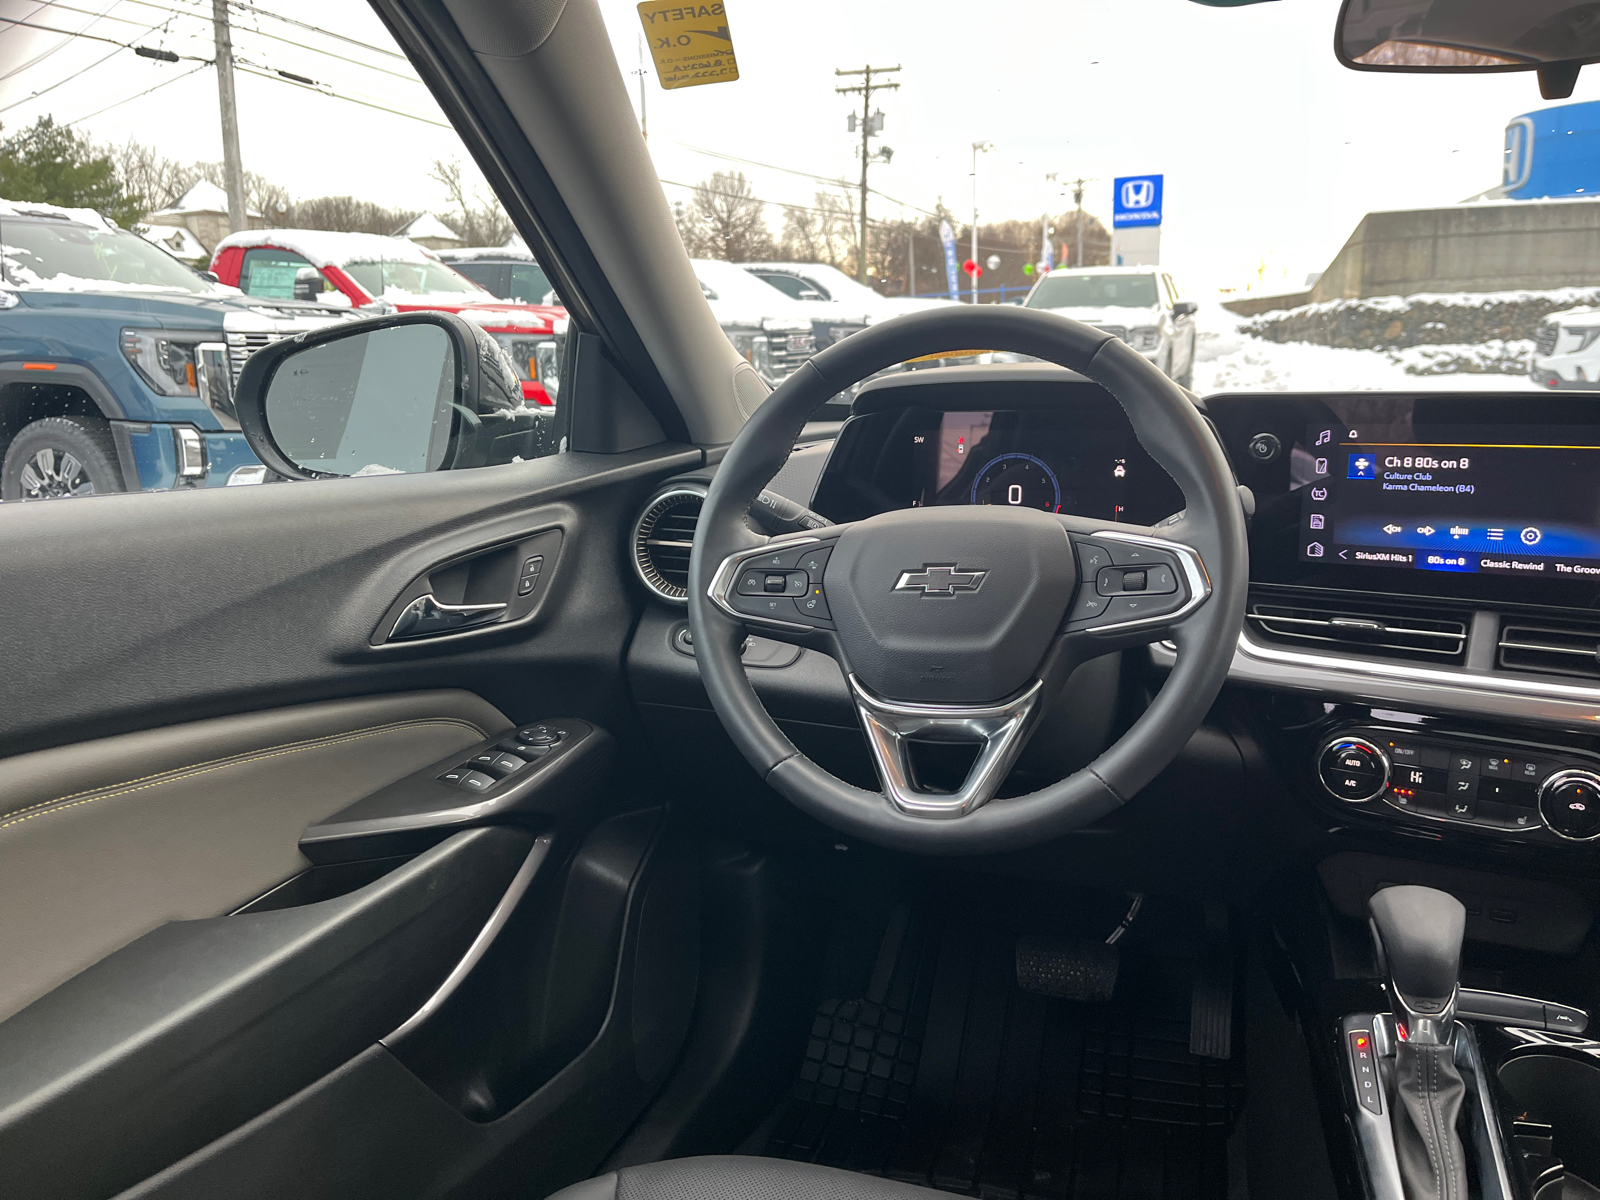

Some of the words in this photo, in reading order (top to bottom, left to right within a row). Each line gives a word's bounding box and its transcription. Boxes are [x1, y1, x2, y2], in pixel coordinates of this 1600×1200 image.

[913, 435, 925, 444] SW
[1384, 456, 1401, 468] Ch
[1403, 456, 1413, 468] 8
[1414, 457, 1439, 469] 80s
[1441, 460, 1457, 469] on
[1459, 457, 1469, 469] 8
[1383, 471, 1413, 480] Culture
[1413, 472, 1433, 481] Club
[1382, 482, 1408, 491] Karma
[1409, 483, 1455, 492] Chameleon
[1455, 484, 1475, 495] (84)
[1008, 484, 1023, 505] 0
[1355, 551, 1390, 561] SiriusXM
[1390, 552, 1407, 562] Hits
[1408, 554, 1413, 563] 1
[1427, 555, 1445, 564] 80s
[1457, 557, 1466, 566] 8
[1480, 559, 1511, 569] Classic
[1511, 561, 1545, 571] Rewind
[1555, 563, 1572, 573] The
[1344, 758, 1361, 767] AUTO
[1410, 770, 1423, 784] Hi
[1344, 779, 1357, 787] A/C
[1357, 1037, 1367, 1048] P
